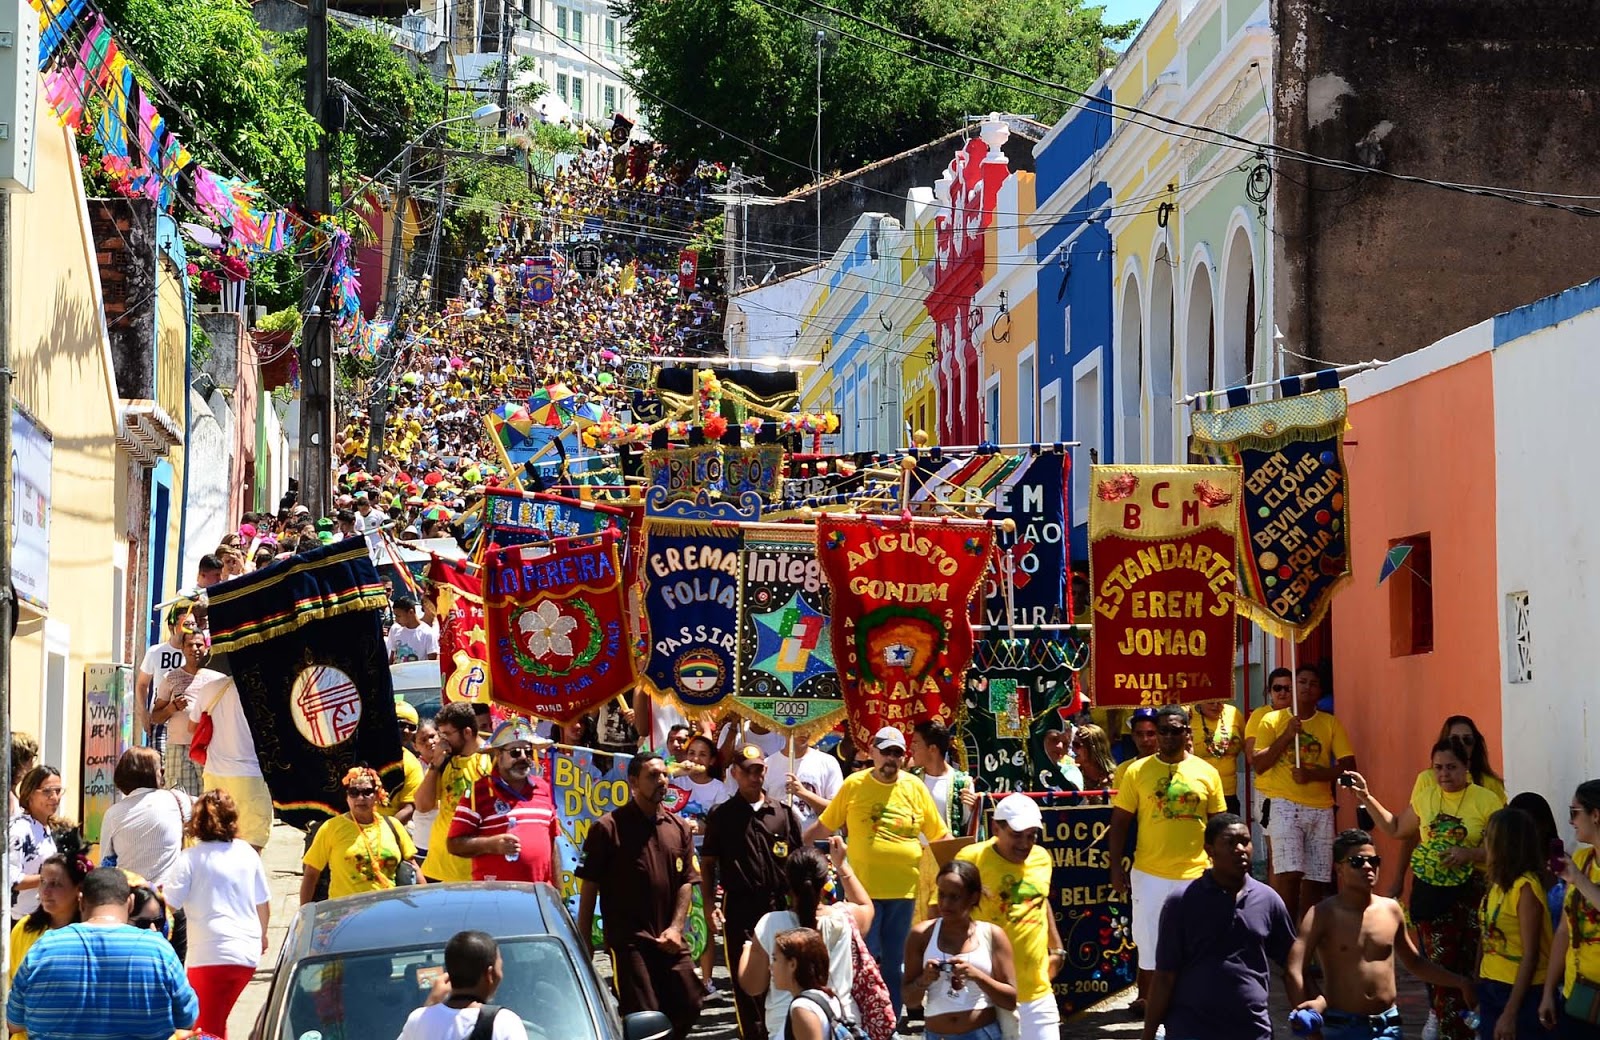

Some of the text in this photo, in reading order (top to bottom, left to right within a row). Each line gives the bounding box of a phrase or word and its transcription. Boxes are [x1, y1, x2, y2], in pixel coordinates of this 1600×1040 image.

[667, 457, 763, 491] BLOCO
[1245, 451, 1290, 496] EREM
[1264, 452, 1320, 509] CLÓVIS
[1253, 468, 1342, 550] BEVILÁQUA
[847, 532, 959, 577] AUGUSTO
[1280, 525, 1308, 552] EM
[1287, 529, 1332, 572] FOLIA
[521, 551, 615, 593] PEREIRA
[1093, 542, 1236, 621] ESTANDARTES
[661, 577, 735, 610] FOLIA
[850, 576, 950, 603] GONDIM
[1131, 591, 1203, 618] EREM
[1271, 565, 1320, 617] DESDE
[656, 625, 736, 657] PASSIR
[1118, 627, 1207, 657] JOMAQ
[1114, 672, 1212, 690] PAULISTA
[90, 704, 117, 720] VIVA
[777, 702, 804, 715] 2009
[866, 699, 927, 720] TERRA
[91, 724, 115, 739] BEM
[555, 758, 630, 809] BLOCO
[1042, 821, 1105, 842] LOCO
[1053, 980, 1109, 995] 03-2000
